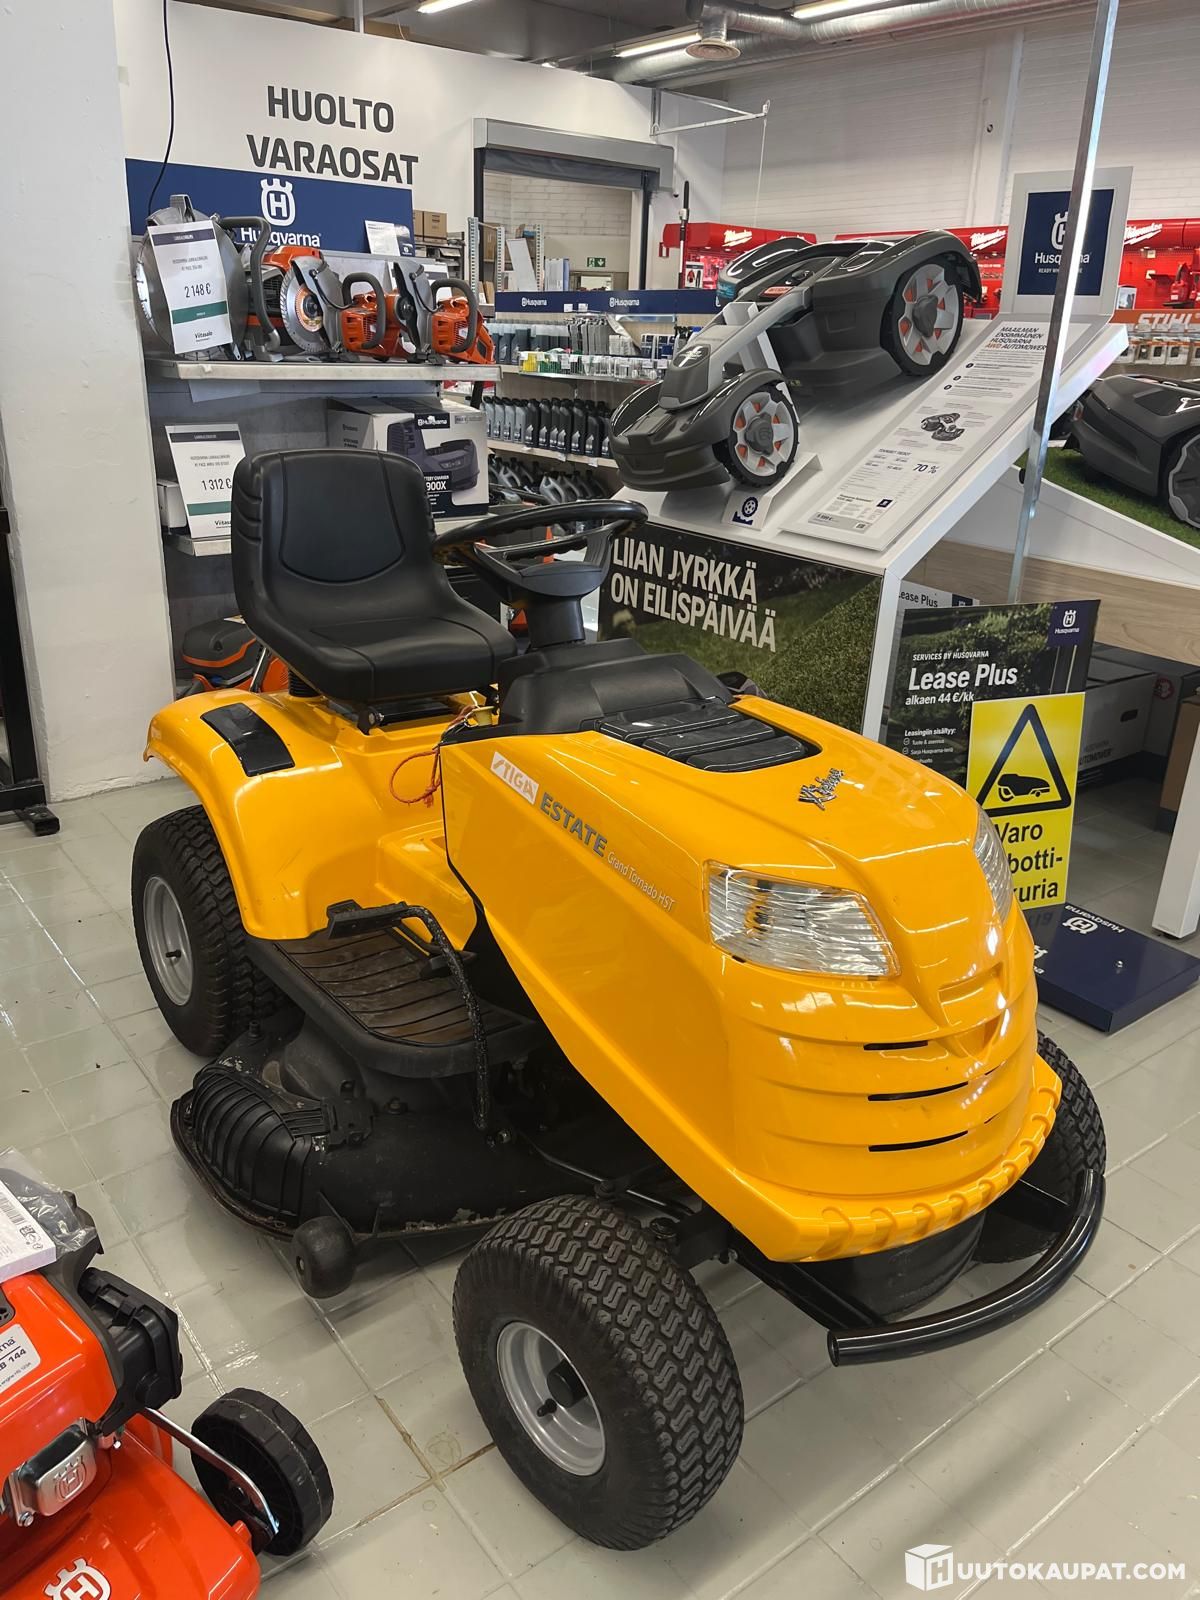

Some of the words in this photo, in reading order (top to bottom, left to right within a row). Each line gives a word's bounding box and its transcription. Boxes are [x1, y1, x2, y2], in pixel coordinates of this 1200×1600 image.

[268, 86, 394, 133] HUOLTO
[247, 134, 418, 185] VARAOSAT
[241, 228, 320, 247] Huqvarna
[1035, 252, 1090, 264] Husqna
[205, 283, 211, 295] €
[1136, 313, 1193, 330] STIHL
[913, 463, 928, 472] 70
[208, 479, 225, 490] 312
[613, 537, 664, 577] LIIAN
[668, 550, 757, 604] JYRKKÄ
[899, 591, 919, 603] ease
[921, 594, 938, 608] Plus
[611, 572, 638, 608] ON
[643, 582, 776, 653] EILISPÄIVÄÄ
[913, 653, 942, 661] SERVICES
[952, 650, 989, 659] HUSQVARNA
[908, 667, 971, 690] Lease
[974, 663, 1018, 686] Plus
[905, 694, 936, 706] alkaen
[938, 693, 951, 703] 44
[952, 691, 975, 702] €/kk
[995, 822, 1043, 843] Varo
[539, 792, 608, 857] ESTATE
[607, 852, 629, 876] Grand
[629, 867, 657, 899] Tornado
[658, 890, 676, 912] HST
[1008, 848, 1063, 874] botti-
[1065, 904, 1125, 933] Husqvarna
[9, 1349, 26, 1362] 144
